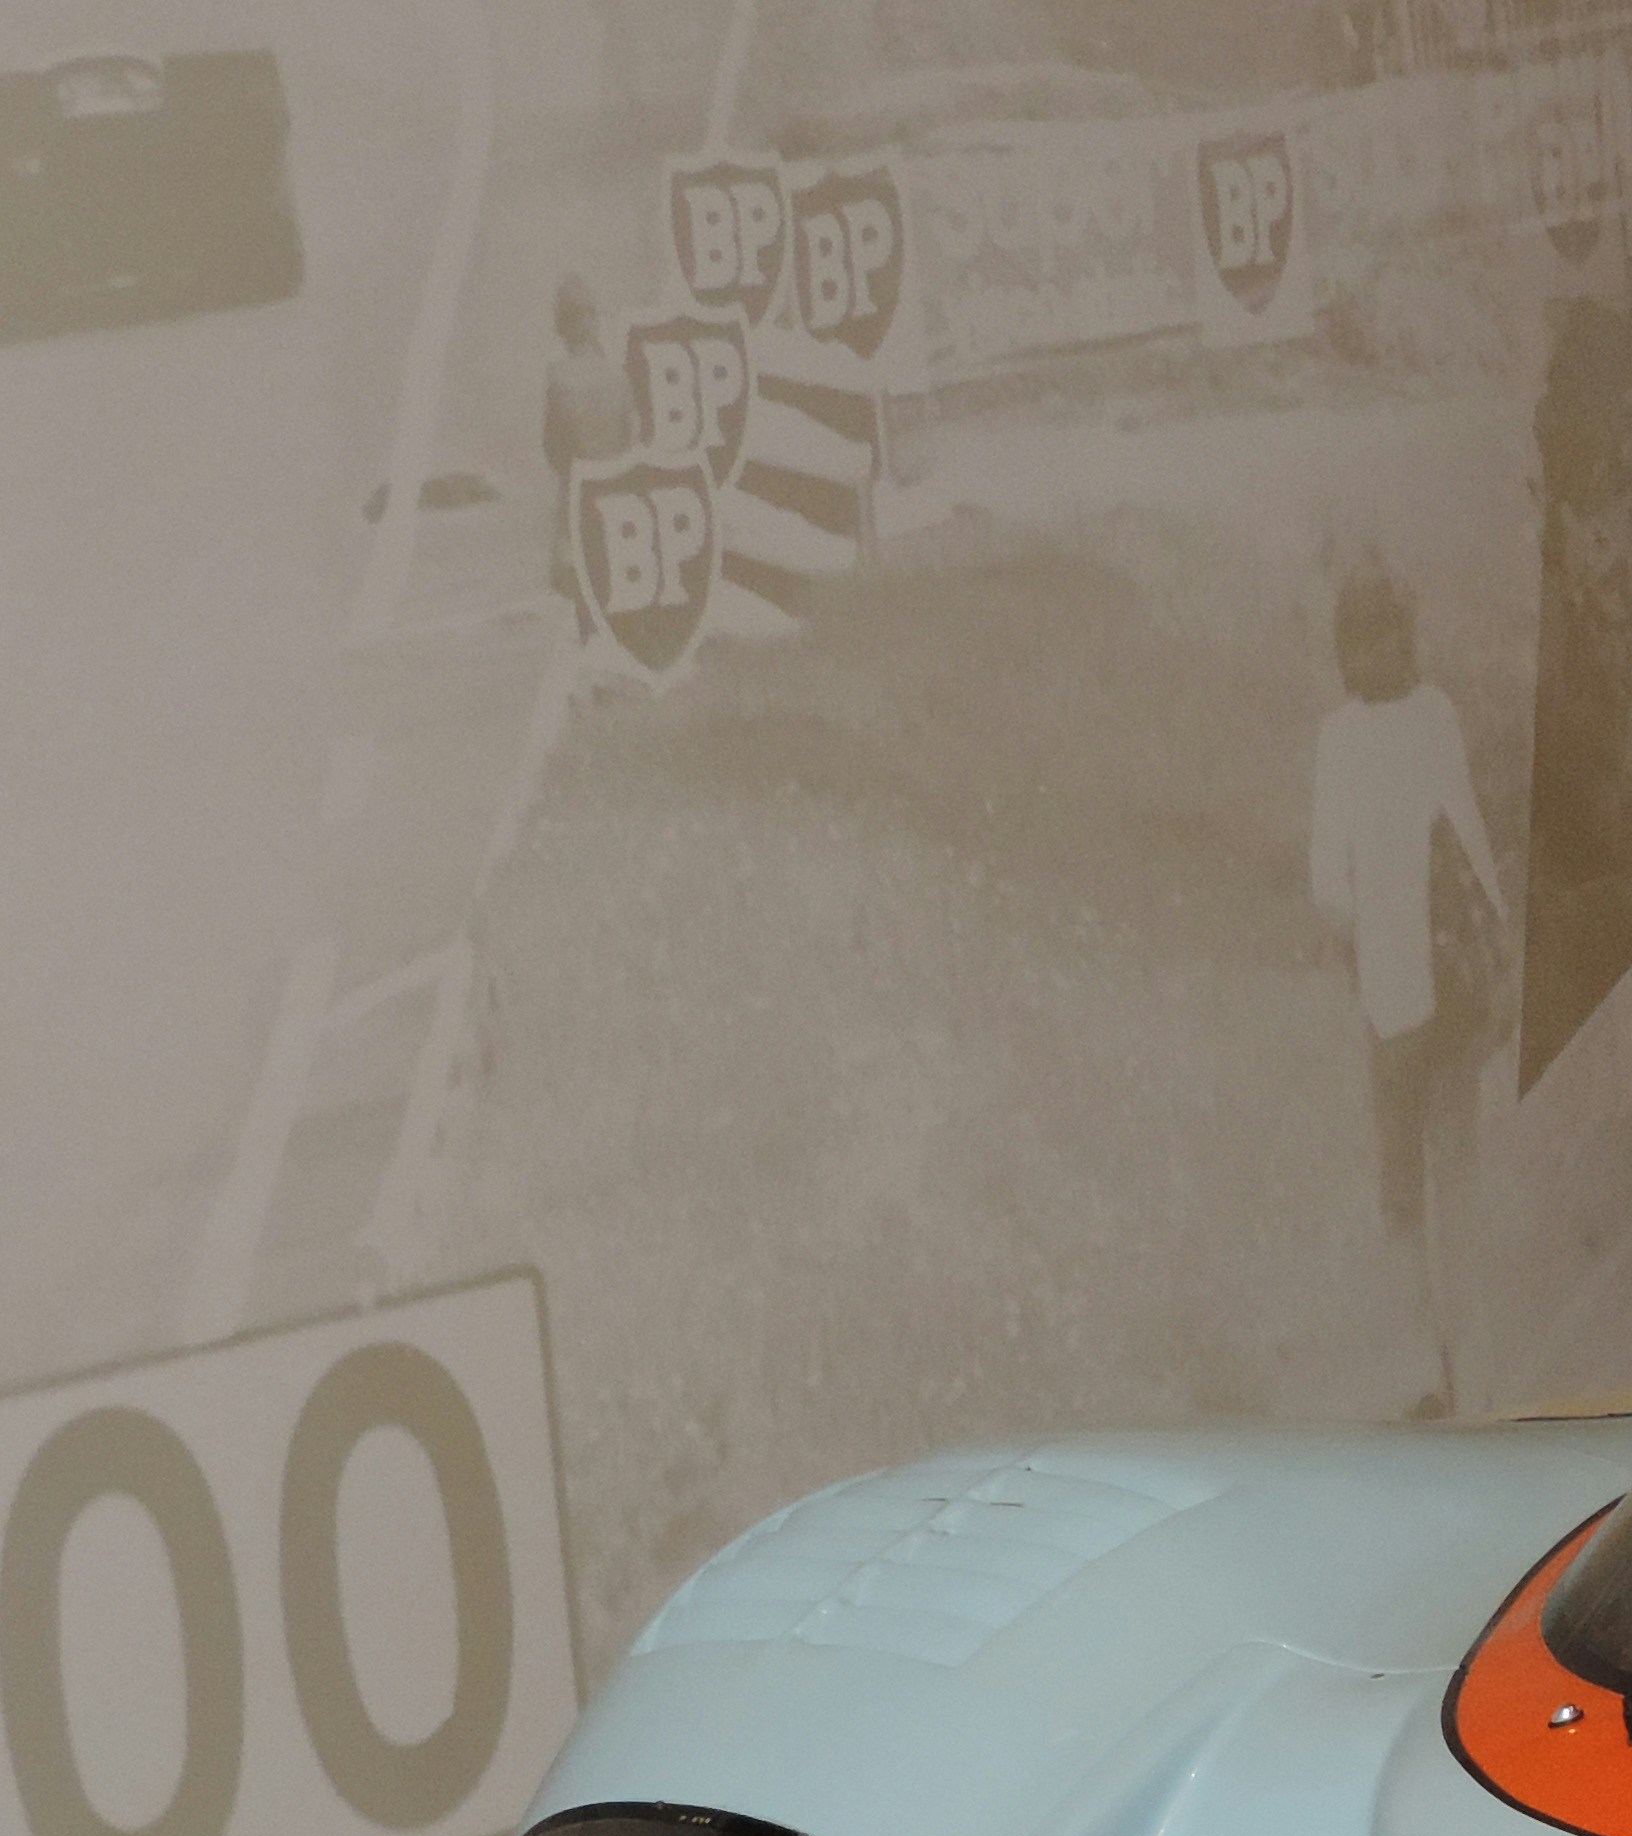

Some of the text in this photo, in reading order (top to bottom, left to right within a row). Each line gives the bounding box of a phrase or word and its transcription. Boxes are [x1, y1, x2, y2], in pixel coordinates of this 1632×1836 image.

[686, 183, 781, 290] BP
[804, 199, 893, 327] BP
[1212, 152, 1291, 271] BP
[646, 338, 742, 454] BP
[600, 488, 706, 612] BP
